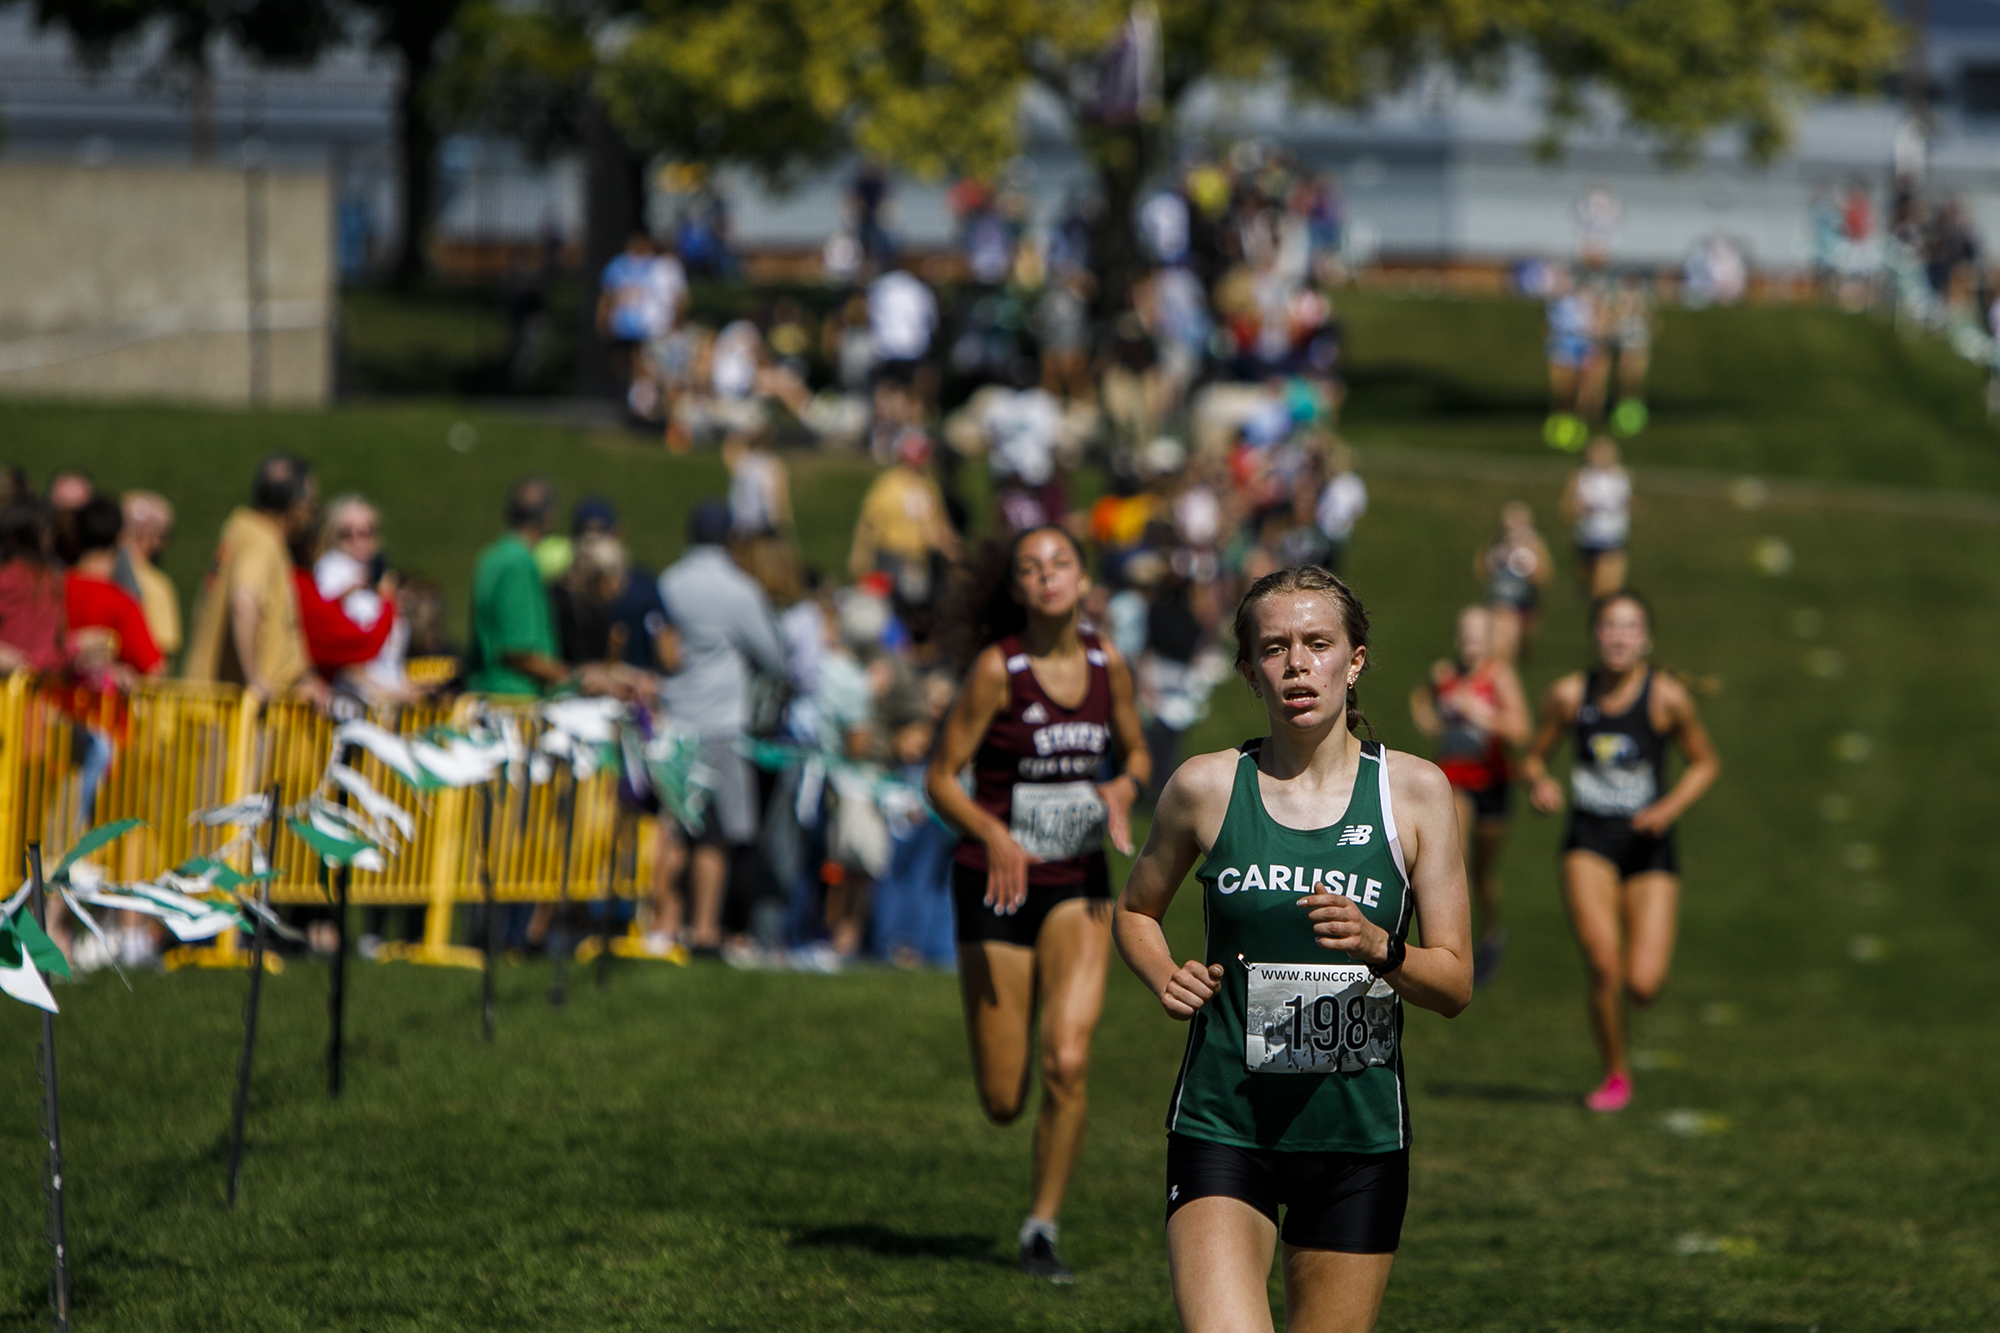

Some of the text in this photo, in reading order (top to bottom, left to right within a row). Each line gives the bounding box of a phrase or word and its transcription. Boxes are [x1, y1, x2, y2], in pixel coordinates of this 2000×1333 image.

[1033, 721, 1106, 757] STATE
[1217, 864, 1383, 908] CARLISLE
[1283, 993, 1369, 1052] 198
